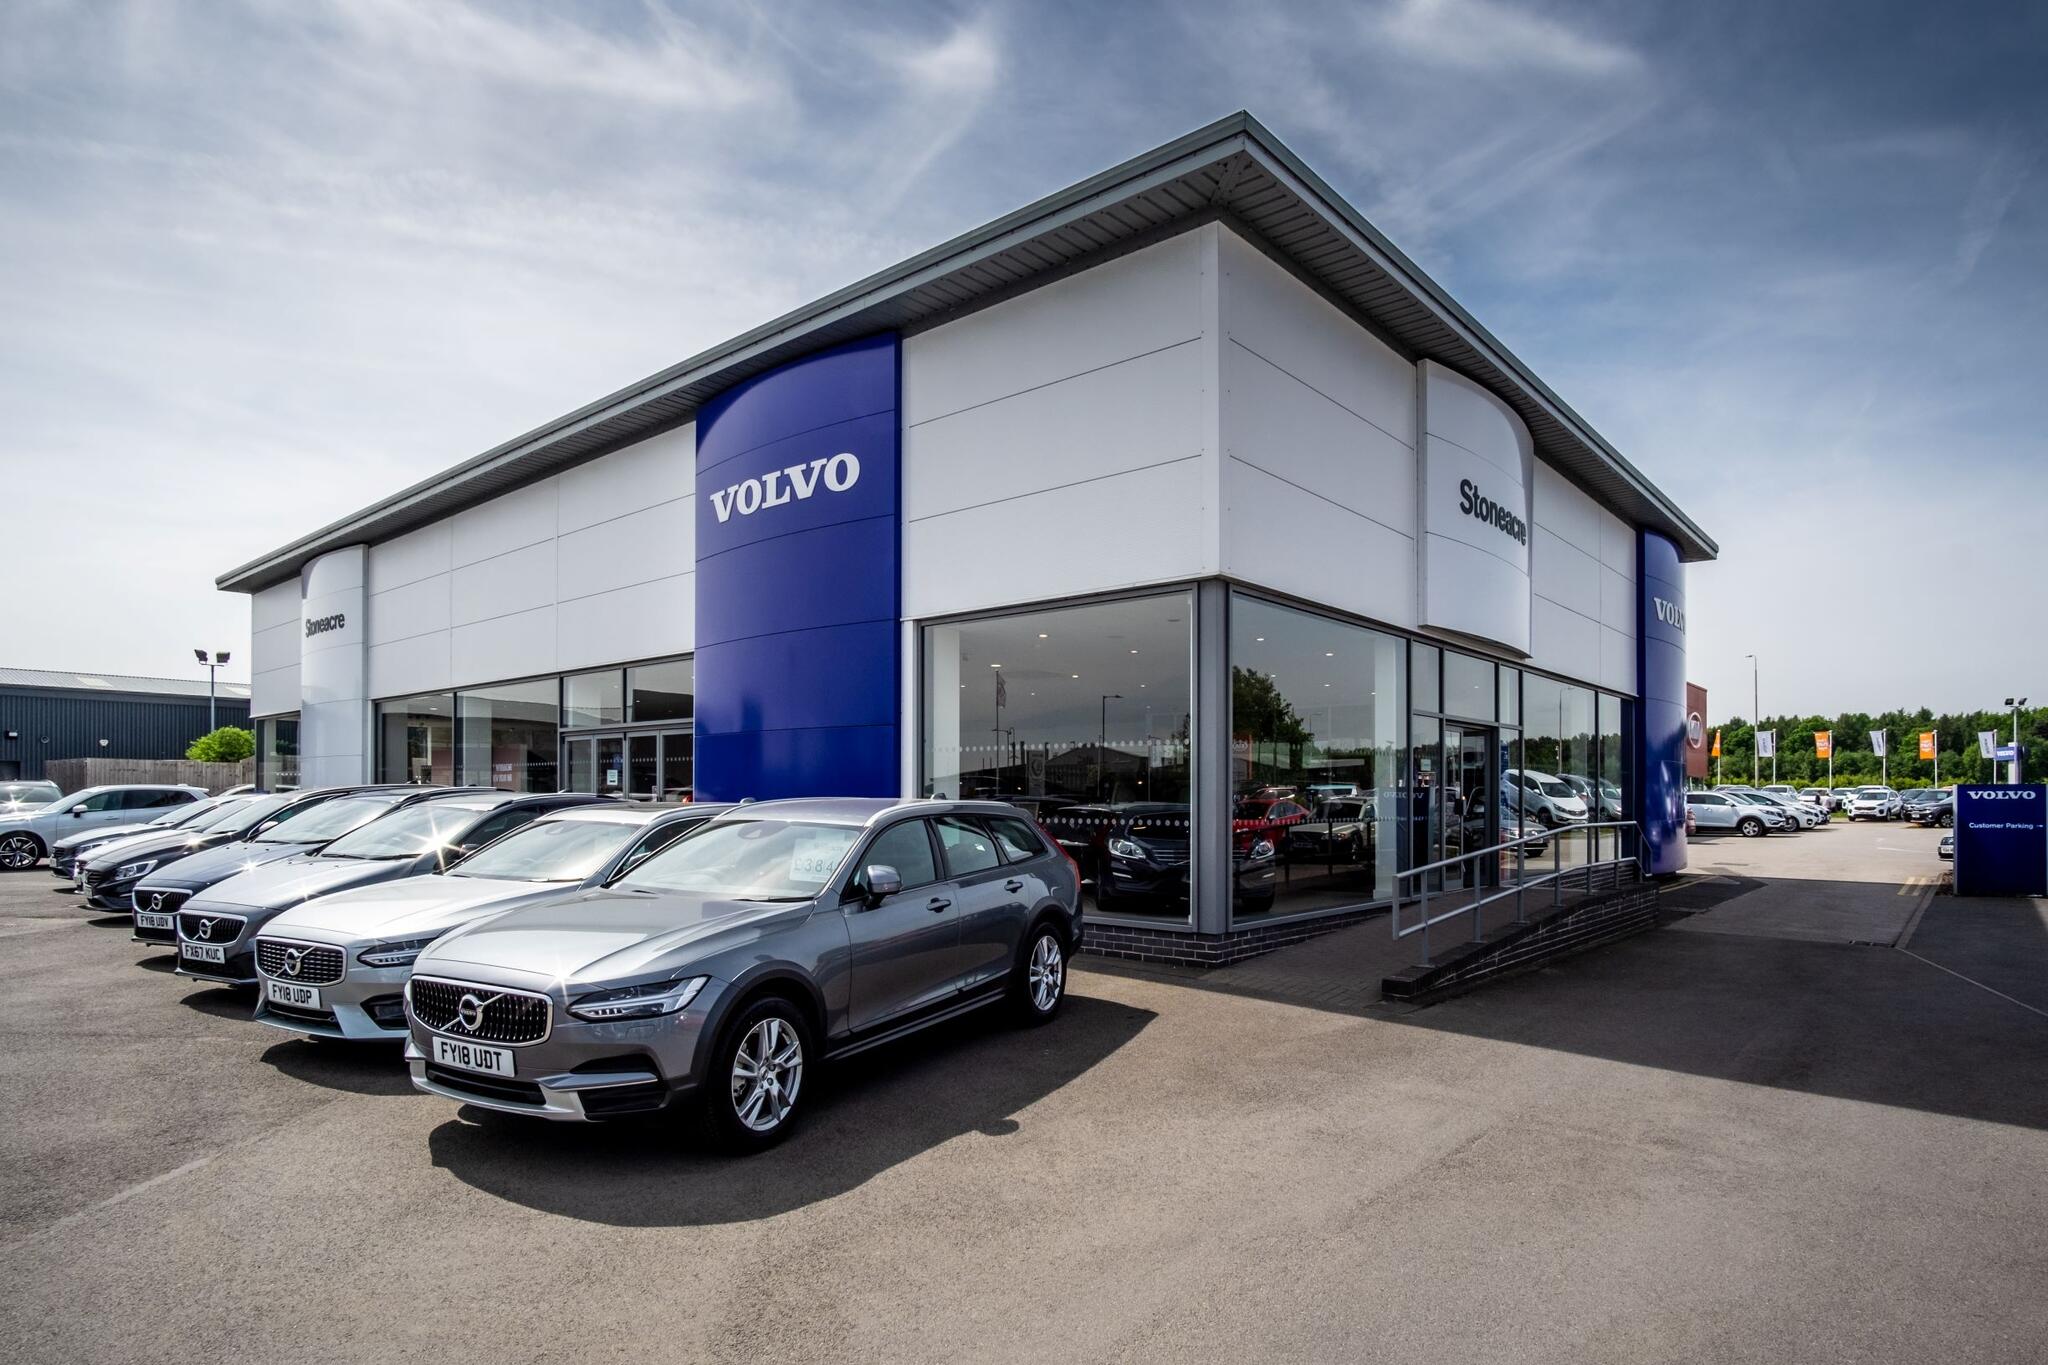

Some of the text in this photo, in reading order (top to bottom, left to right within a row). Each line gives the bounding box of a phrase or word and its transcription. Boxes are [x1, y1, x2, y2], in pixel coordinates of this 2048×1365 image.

[710, 453, 860, 523] VOLVO
[1460, 479, 1526, 546] Stoneacre
[305, 613, 345, 638] Stoneacre
[1967, 790, 2036, 799] VOLVO
[2005, 822, 2034, 830] Parking
[184, 945, 220, 960] FX67 KUC
[272, 984, 312, 1004] FY18 UDP
[440, 1041, 502, 1071] FY18 UDT
